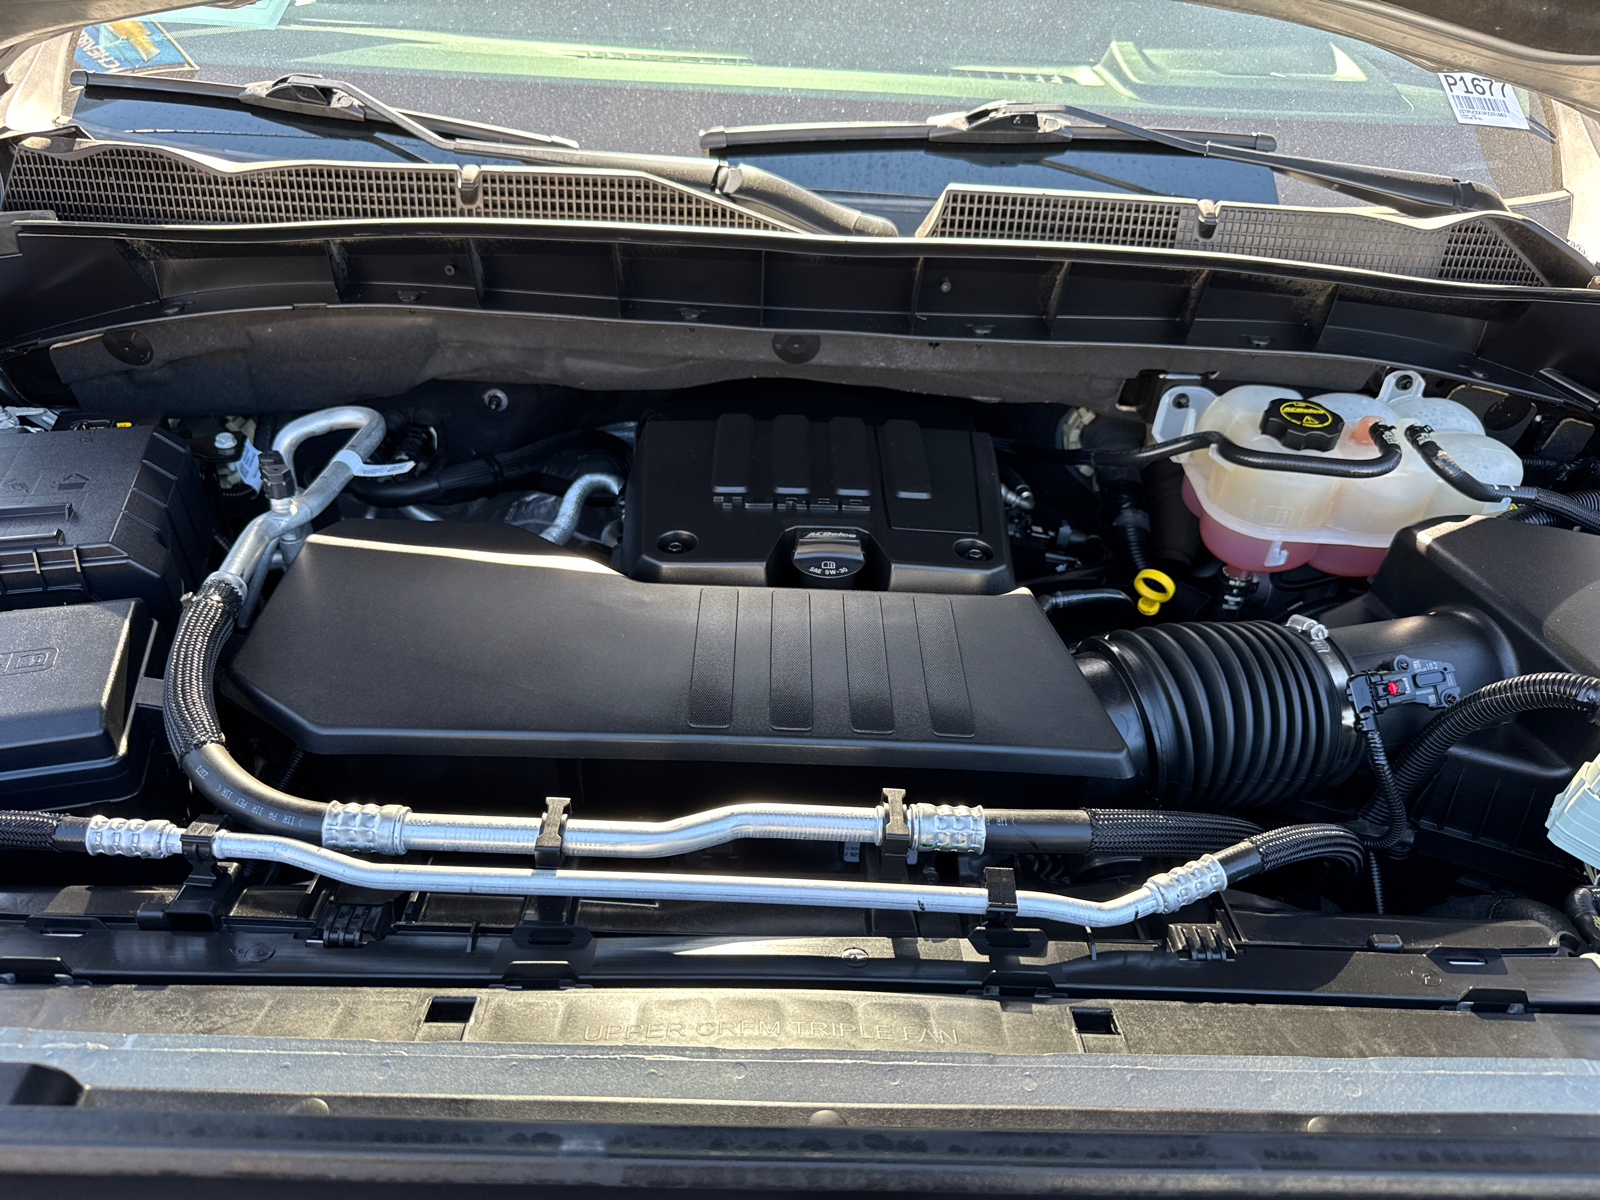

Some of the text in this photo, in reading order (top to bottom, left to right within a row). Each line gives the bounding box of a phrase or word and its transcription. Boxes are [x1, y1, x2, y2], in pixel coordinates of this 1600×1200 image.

[1443, 74, 1506, 99] P1677
[804, 531, 857, 539] ACDelco
[808, 566, 849, 575] SAE 5W-30
[235, 797, 249, 809] PET
[583, 1020, 960, 1045] UPPER CRFM TRIPLE FAN
